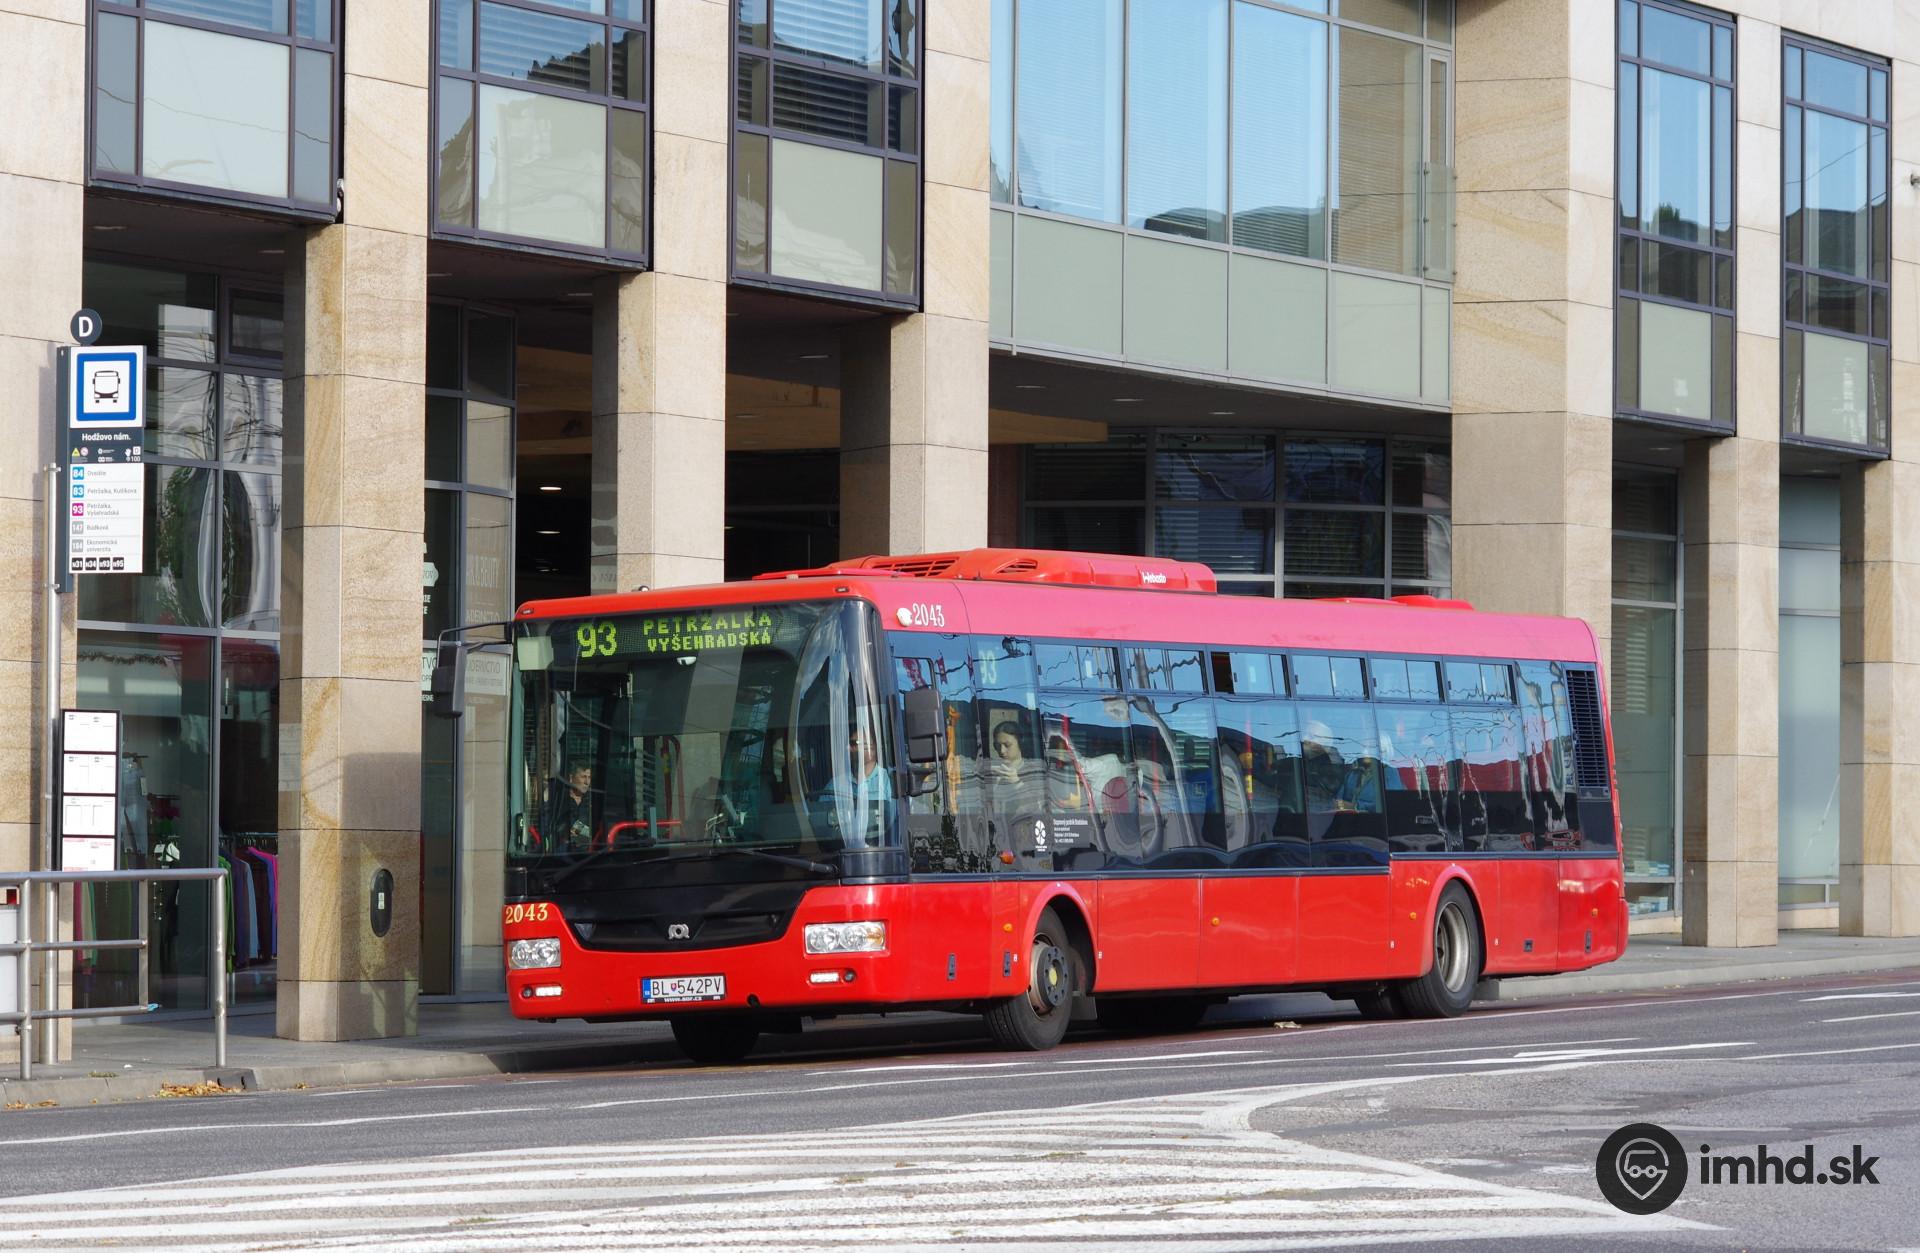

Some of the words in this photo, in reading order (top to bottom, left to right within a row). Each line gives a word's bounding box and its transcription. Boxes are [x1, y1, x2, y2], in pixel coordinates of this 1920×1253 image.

[78, 316, 93, 338] D
[81, 432, 113, 441] Hodžovo
[113, 432, 132, 441] nám.
[73, 469, 84, 478] 84
[73, 487, 84, 496] 83
[72, 505, 83, 514] 93
[1141, 571, 1167, 584] Webasto
[912, 603, 945, 627] 2043
[576, 620, 617, 658] 93
[643, 611, 772, 636] PETRŽALKA
[647, 627, 772, 653] VYŠEHRADSKÁ
[505, 902, 549, 924] 2043
